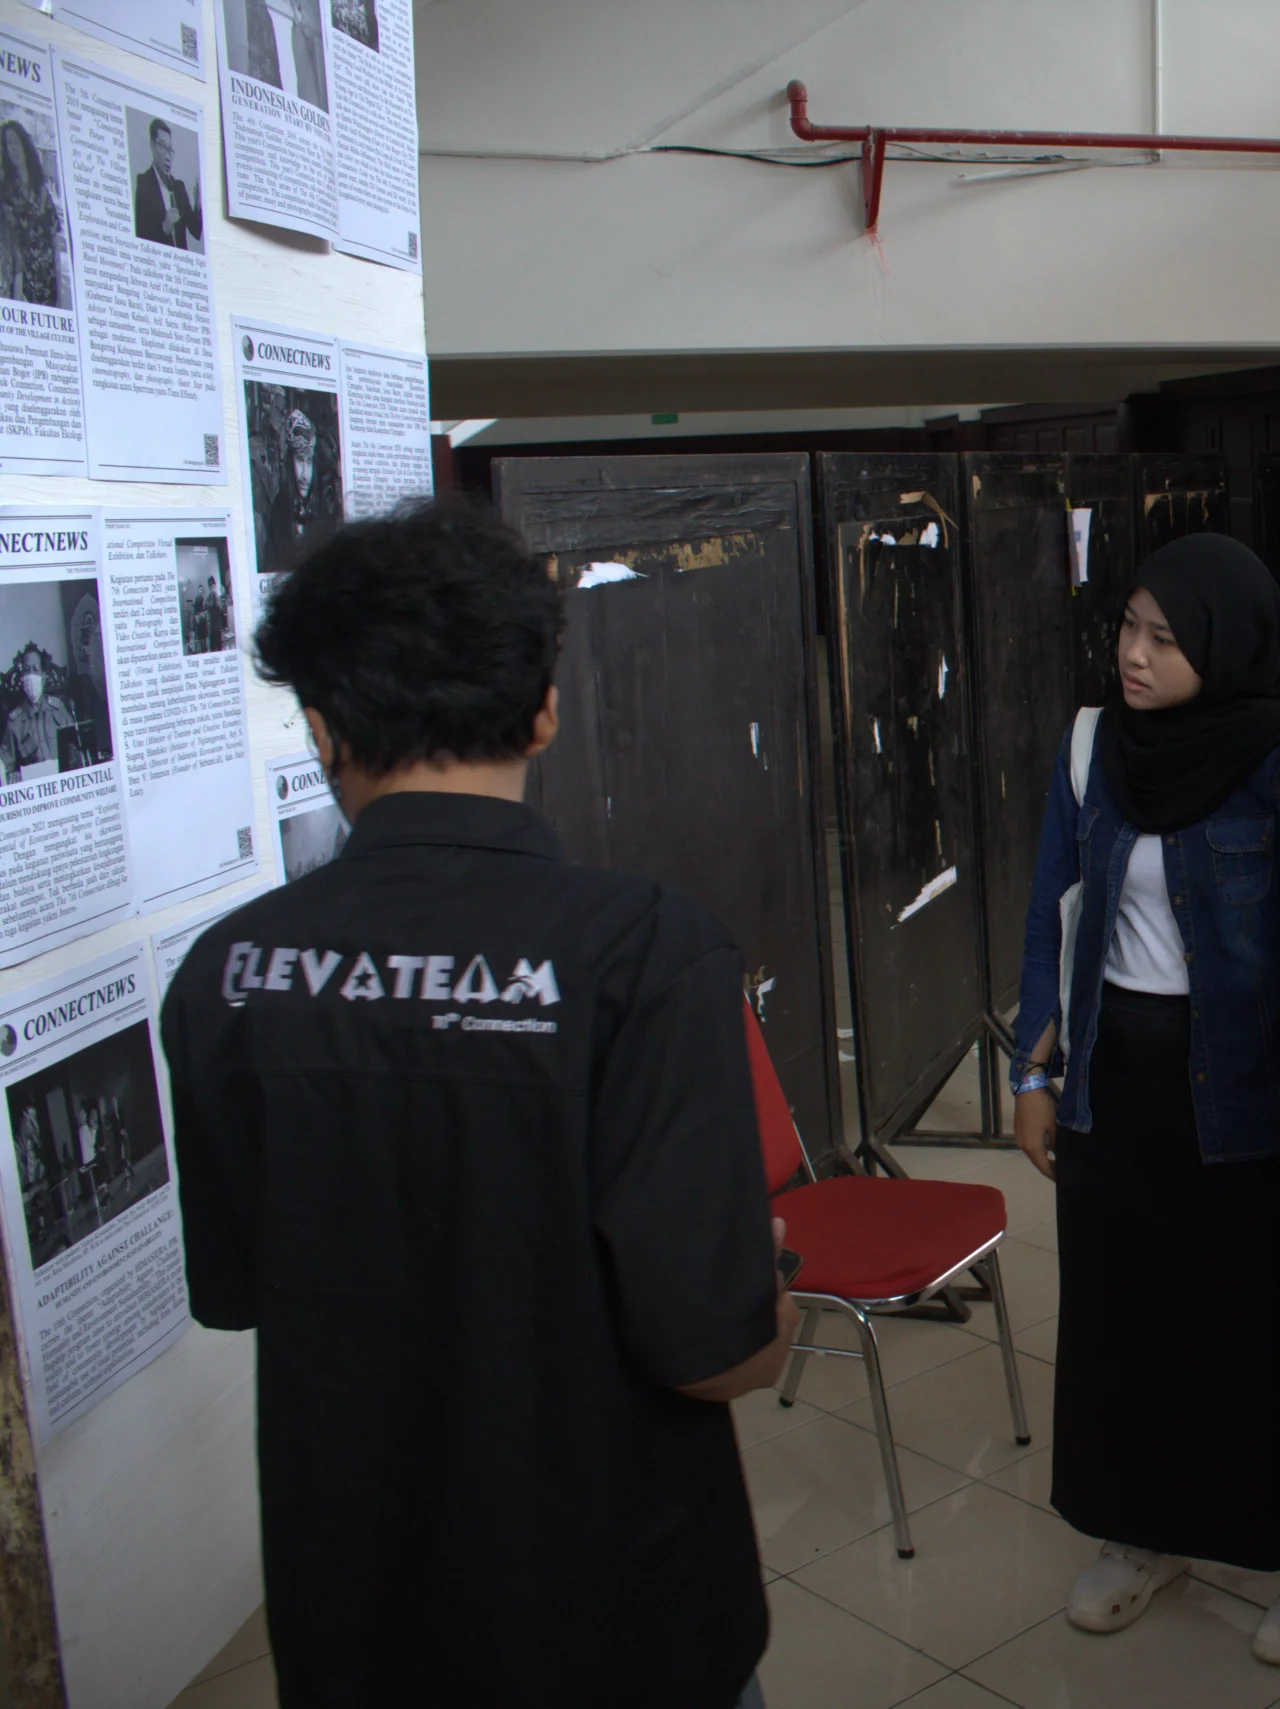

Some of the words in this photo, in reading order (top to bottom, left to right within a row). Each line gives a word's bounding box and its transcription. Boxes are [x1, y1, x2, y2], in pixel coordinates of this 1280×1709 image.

[230, 77, 299, 116] INDONESIAN
[300, 106, 331, 132] GOLDEN
[231, 95, 281, 118] GENERATION
[0, 306, 28, 325] OUR
[31, 311, 75, 333] FUTURE
[258, 342, 331, 371] CONNECTNEWS
[0, 531, 88, 553] NECTNEWS
[36, 780, 58, 798] THE
[60, 768, 114, 793] POTENTIAL
[23, 807, 32, 818] TO
[32, 800, 59, 814] IMPROVE
[60, 791, 95, 807] COMMUNITY
[24, 973, 136, 1041] CONNECTNEWS
[461, 1015, 557, 1032] Connection
[38, 1264, 94, 1309] ADAPTIBILITY
[96, 1239, 128, 1270] AGAINST
